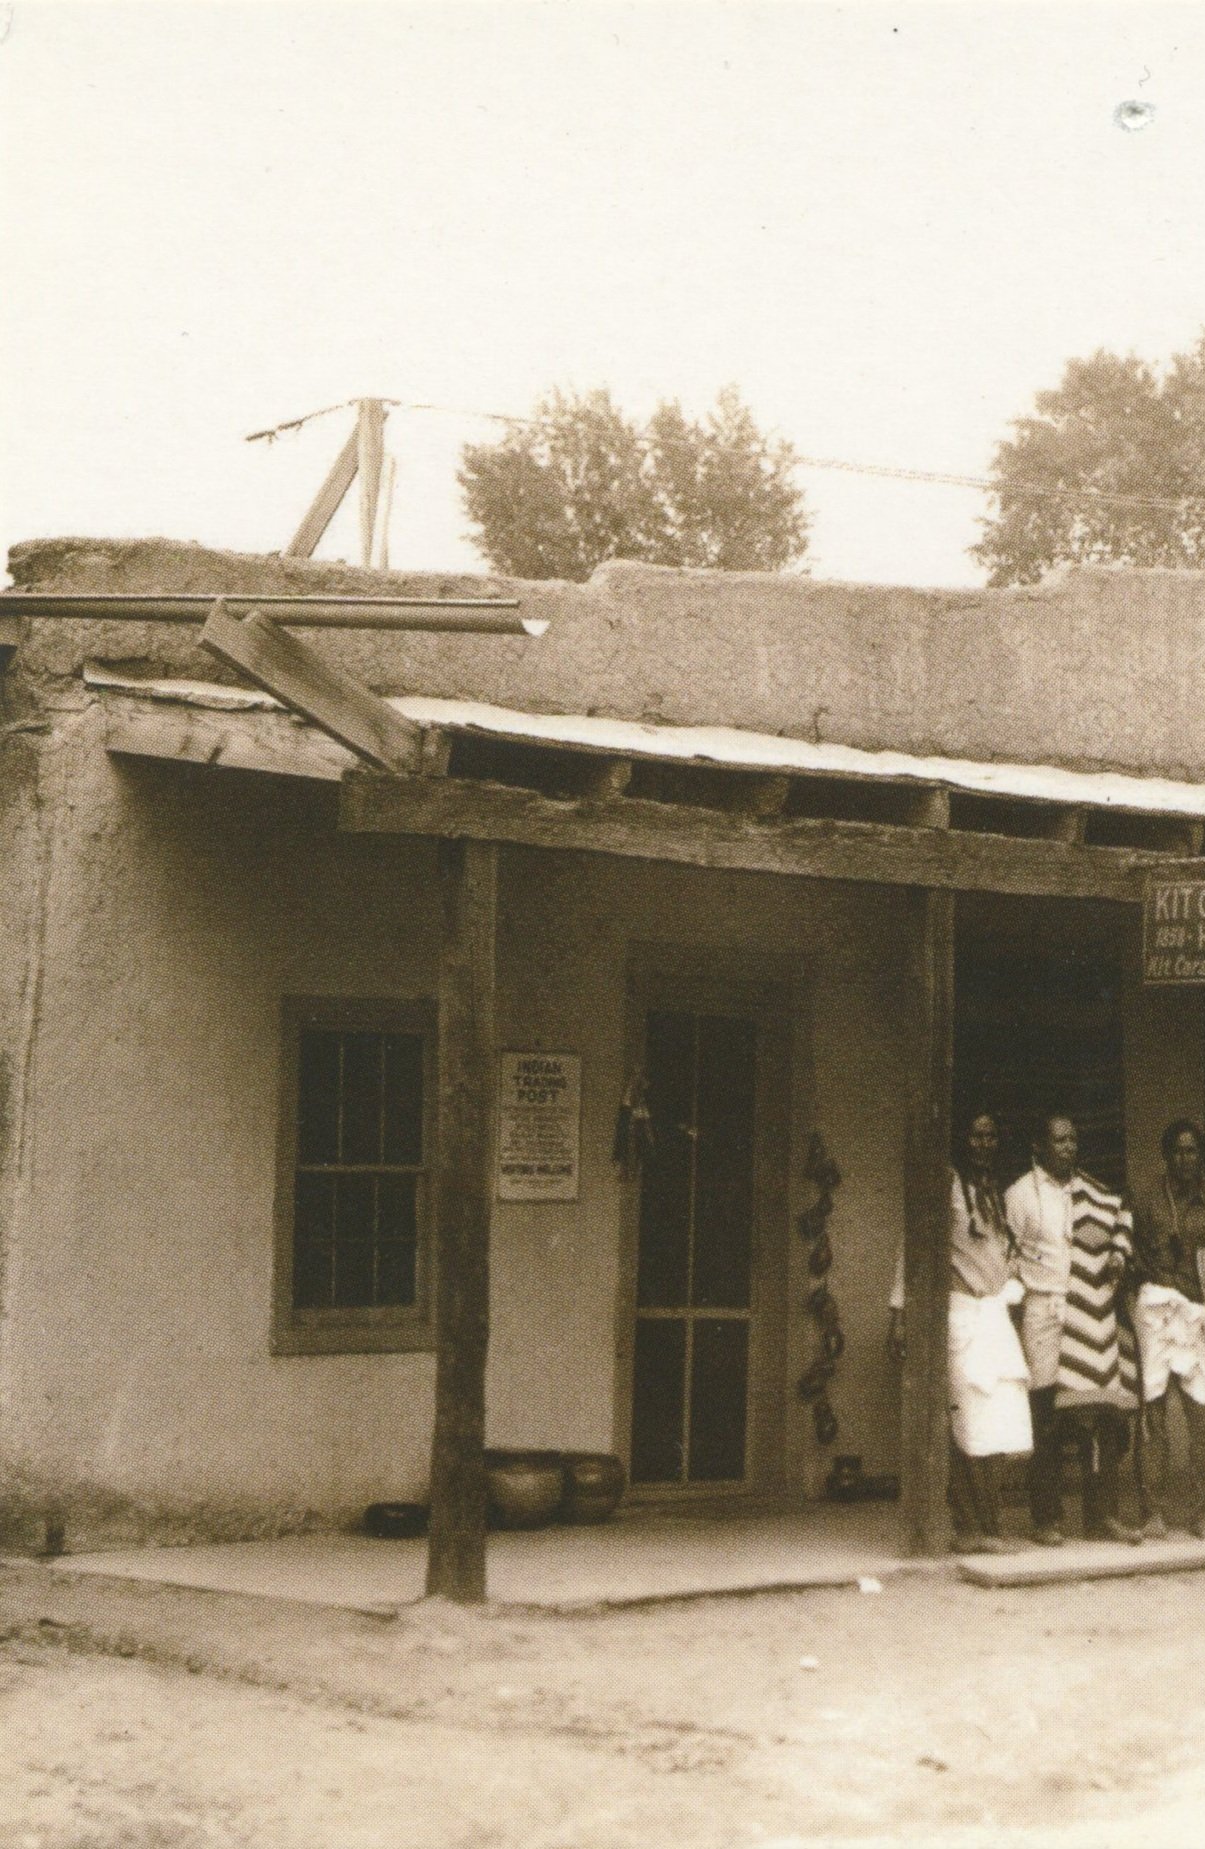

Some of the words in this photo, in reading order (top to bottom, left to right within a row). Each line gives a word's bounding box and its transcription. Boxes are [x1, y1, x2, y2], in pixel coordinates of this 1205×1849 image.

[1155, 887, 1193, 920] KIT
[1148, 955, 1171, 977] Kit
[517, 1060, 561, 1074] INDIAN
[512, 1075, 567, 1089] TRADING
[517, 1088, 560, 1103] POST
